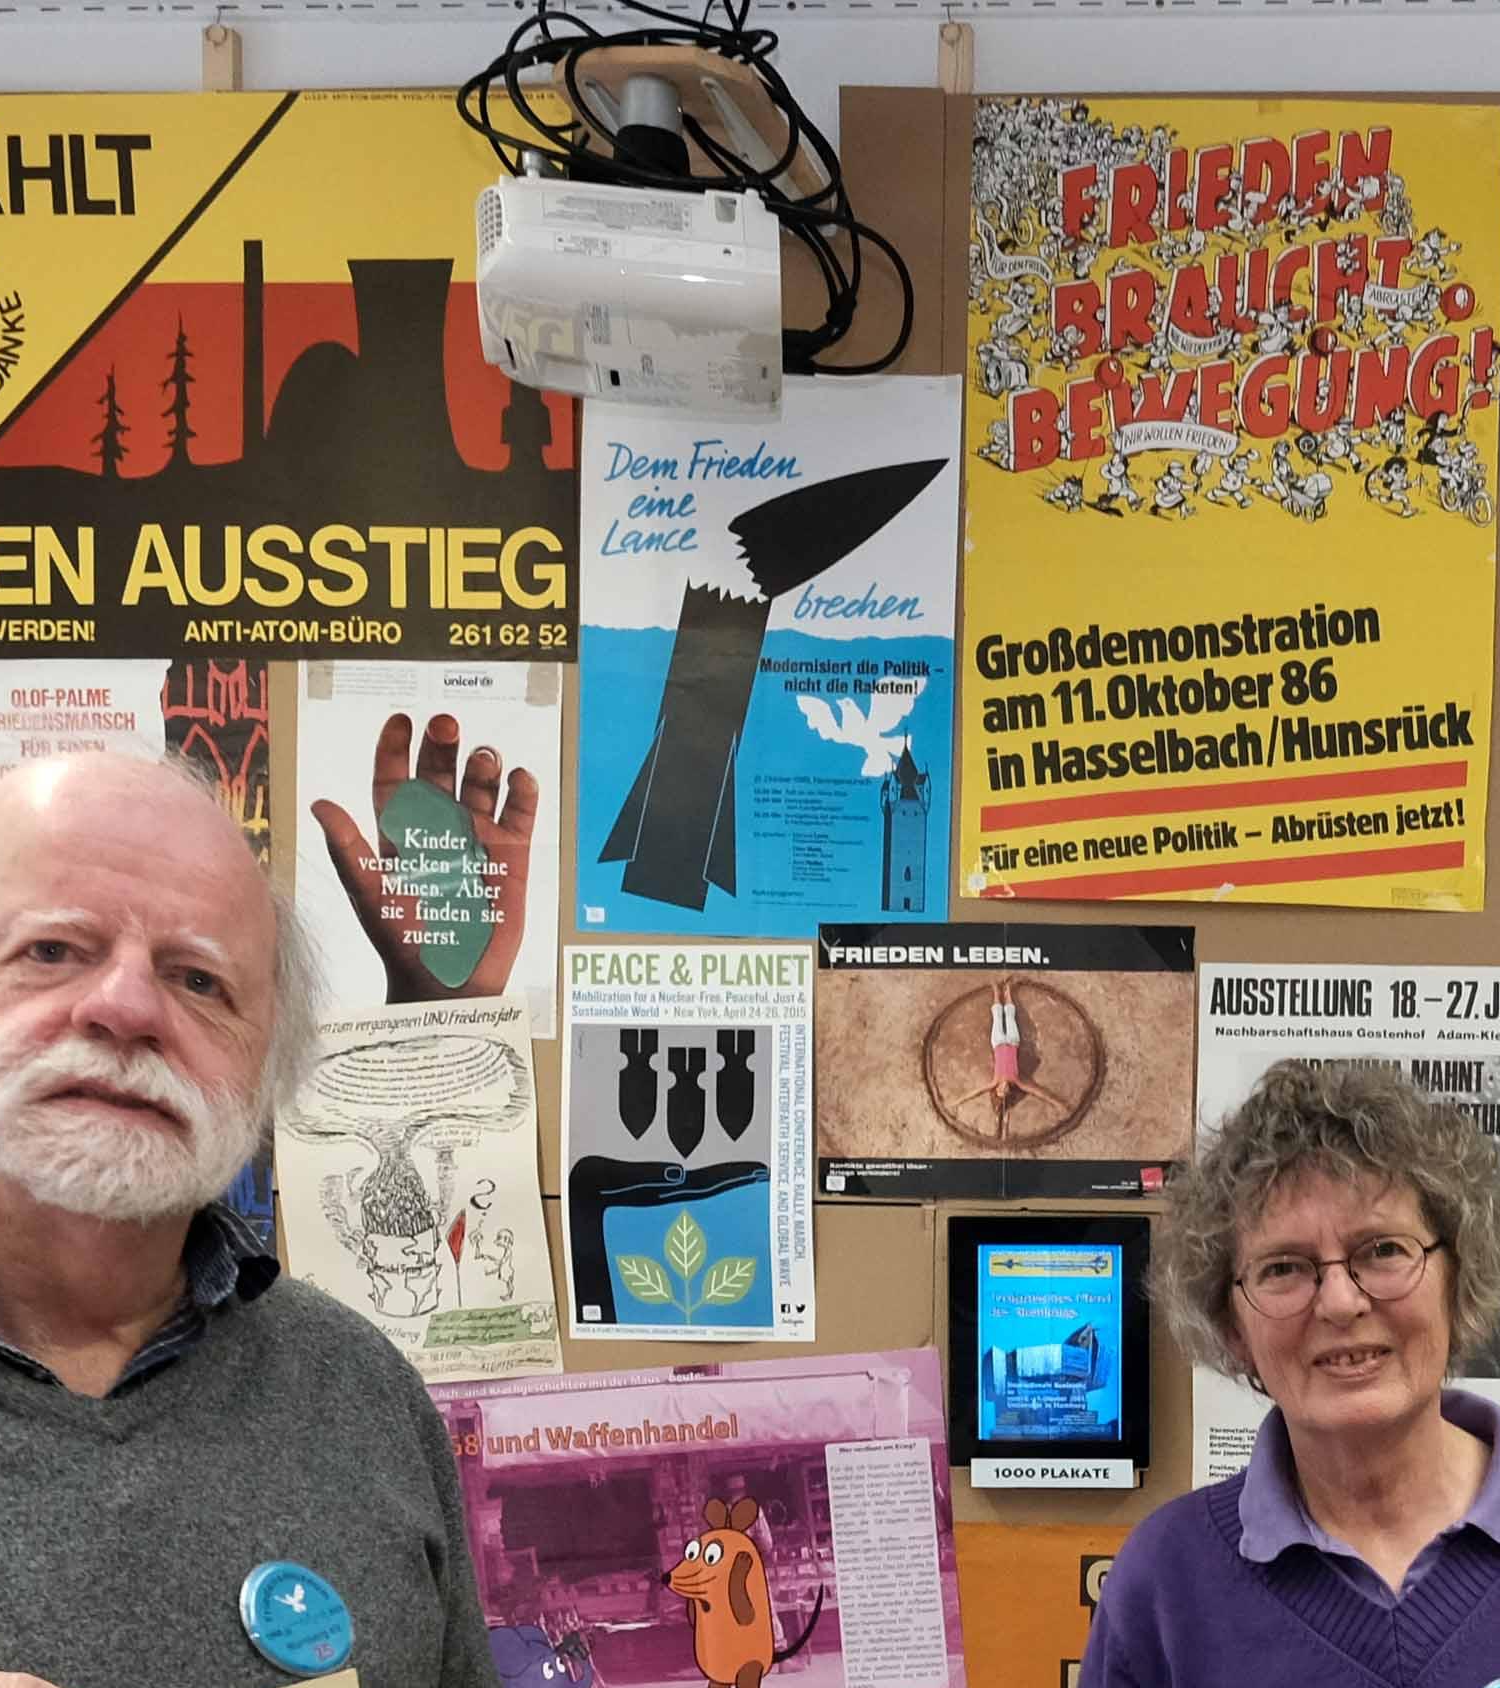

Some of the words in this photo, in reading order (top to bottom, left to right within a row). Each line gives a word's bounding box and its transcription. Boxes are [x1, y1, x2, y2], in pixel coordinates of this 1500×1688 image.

[1060, 126, 1392, 251] FRIEDEN
[1052, 235, 1414, 361] BRAUCHT
[1008, 327, 1496, 473] BEWEGUNG!
[604, 441, 679, 483] Dem
[688, 439, 802, 482] Frieden
[121, 524, 567, 611] AUSSTIEG
[794, 582, 924, 621] brechen
[184, 618, 402, 645] ANTI-ATOM-BÜRO
[976, 603, 1381, 681] Großdemonstration
[784, 678, 822, 693] nicht
[825, 678, 849, 694] die
[852, 679, 918, 696] Raketen!
[987, 745, 1026, 792] in
[1031, 701, 1474, 787] Hasselbach/Hunsrück
[403, 828, 468, 850] Kinder
[358, 854, 452, 875] verstecken
[461, 856, 509, 878] keine
[571, 952, 662, 986] PEACE
[669, 952, 692, 986] &
[700, 953, 809, 988] PLANET
[829, 945, 944, 965] FRIEDEN
[953, 946, 1050, 965] LEBEN.
[1214, 1025, 1353, 1041] Nachbarschaftshaus
[1357, 1027, 1426, 1041] Gostenhof
[487, 1428, 541, 1456] und
[547, 1413, 739, 1453] Waffenhandel
[994, 1467, 1036, 1480] 1000
[1041, 1467, 1110, 1480] PLAKATE
